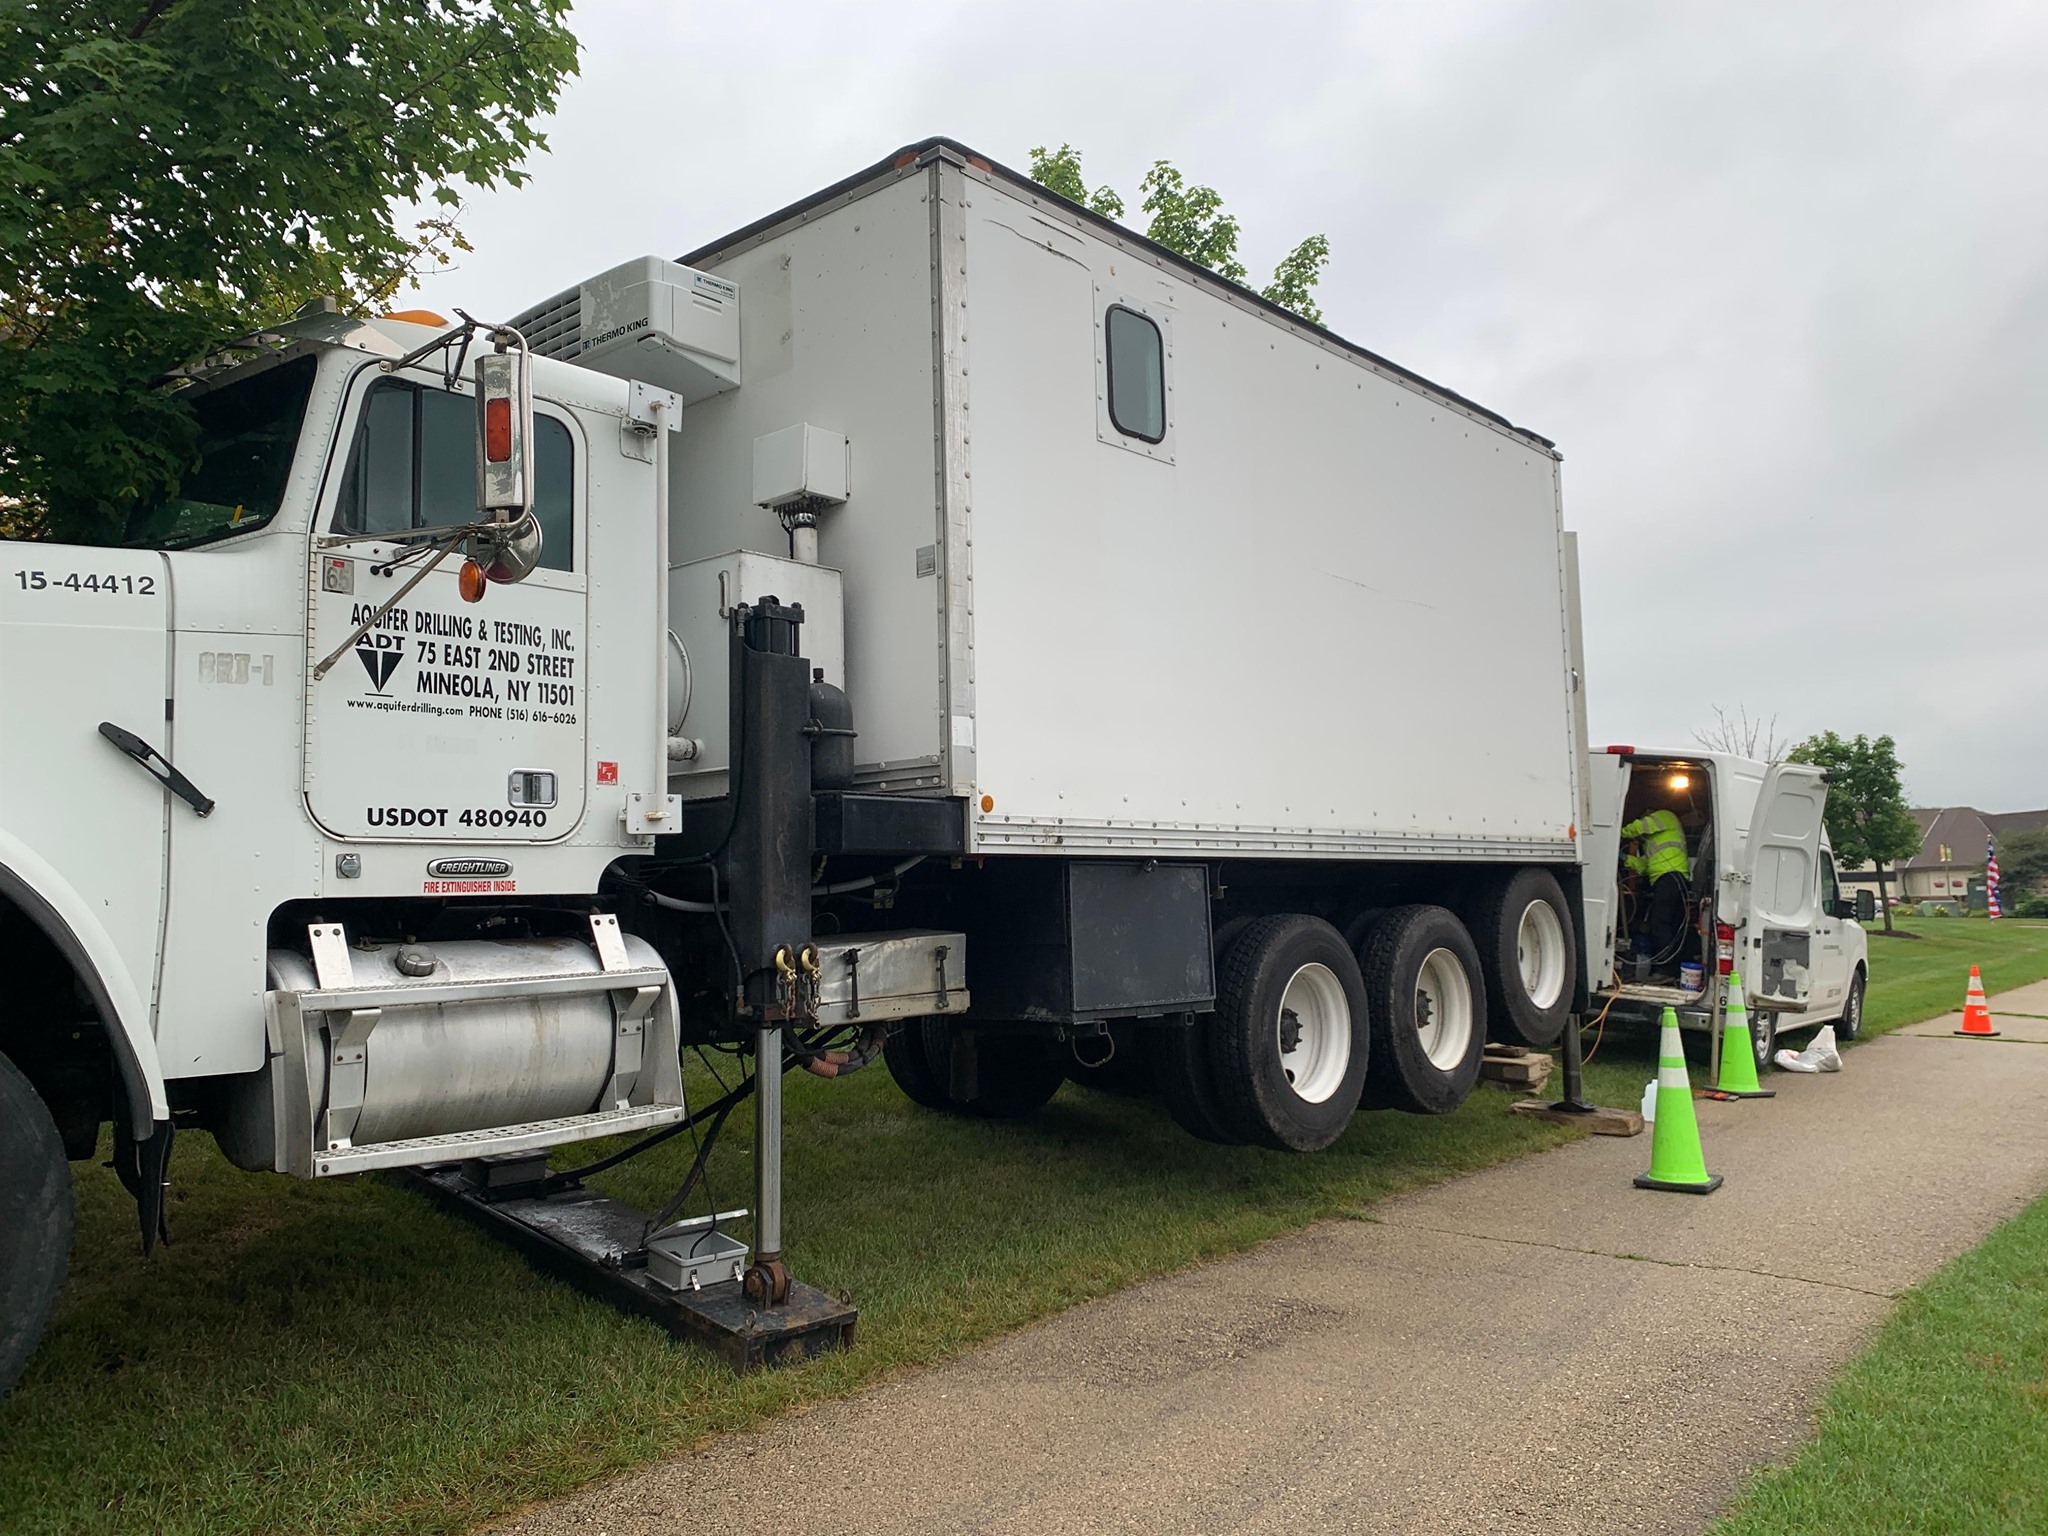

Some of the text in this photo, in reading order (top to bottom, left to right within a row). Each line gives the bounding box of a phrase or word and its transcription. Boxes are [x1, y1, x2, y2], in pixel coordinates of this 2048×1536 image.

[592, 326, 625, 346] THERMO
[627, 318, 648, 333] KING
[15, 570, 156, 595] 15-44412
[350, 603, 574, 652] AQUIFER DRILLING & TESTING, INC.
[355, 632, 406, 650] ADT
[417, 641, 574, 678] 75 EAST 2ND STREET
[417, 671, 574, 706] MINEOLA, NY 11501
[347, 700, 576, 725] www.aquiferdrilling.com PHONE (516) 616-6026
[367, 808, 547, 828] USDOT 480940
[439, 862, 506, 873] FREIGHTLINER
[424, 880, 516, 893] FIRE EXTINGUISHER INSIDE
